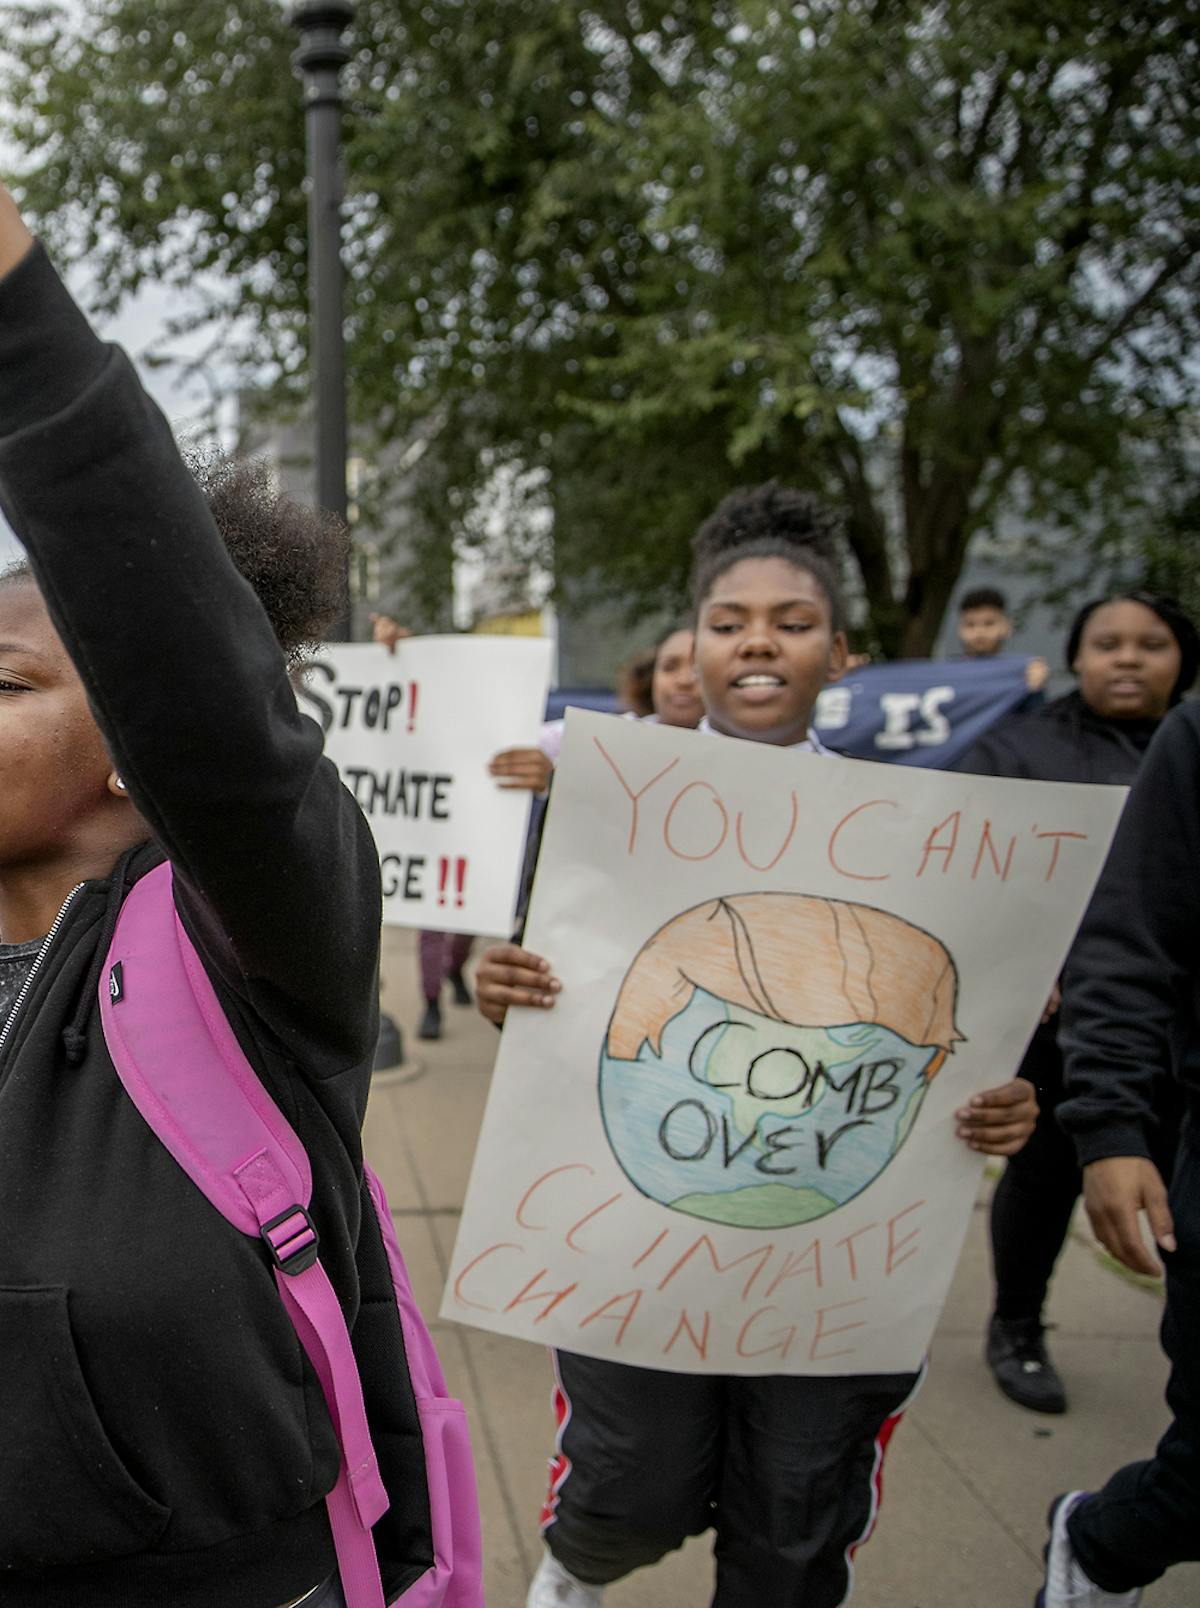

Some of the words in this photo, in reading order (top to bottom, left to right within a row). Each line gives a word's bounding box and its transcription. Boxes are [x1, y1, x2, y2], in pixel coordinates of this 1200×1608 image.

[874, 685, 955, 750] IS
[346, 765, 452, 819] IMATE
[593, 735, 799, 873] YOU
[827, 799, 1089, 882] CAN'T
[688, 1019, 906, 1116] COMB
[514, 1163, 926, 1301] CLIMATE
[453, 1242, 870, 1361] CHANGE
